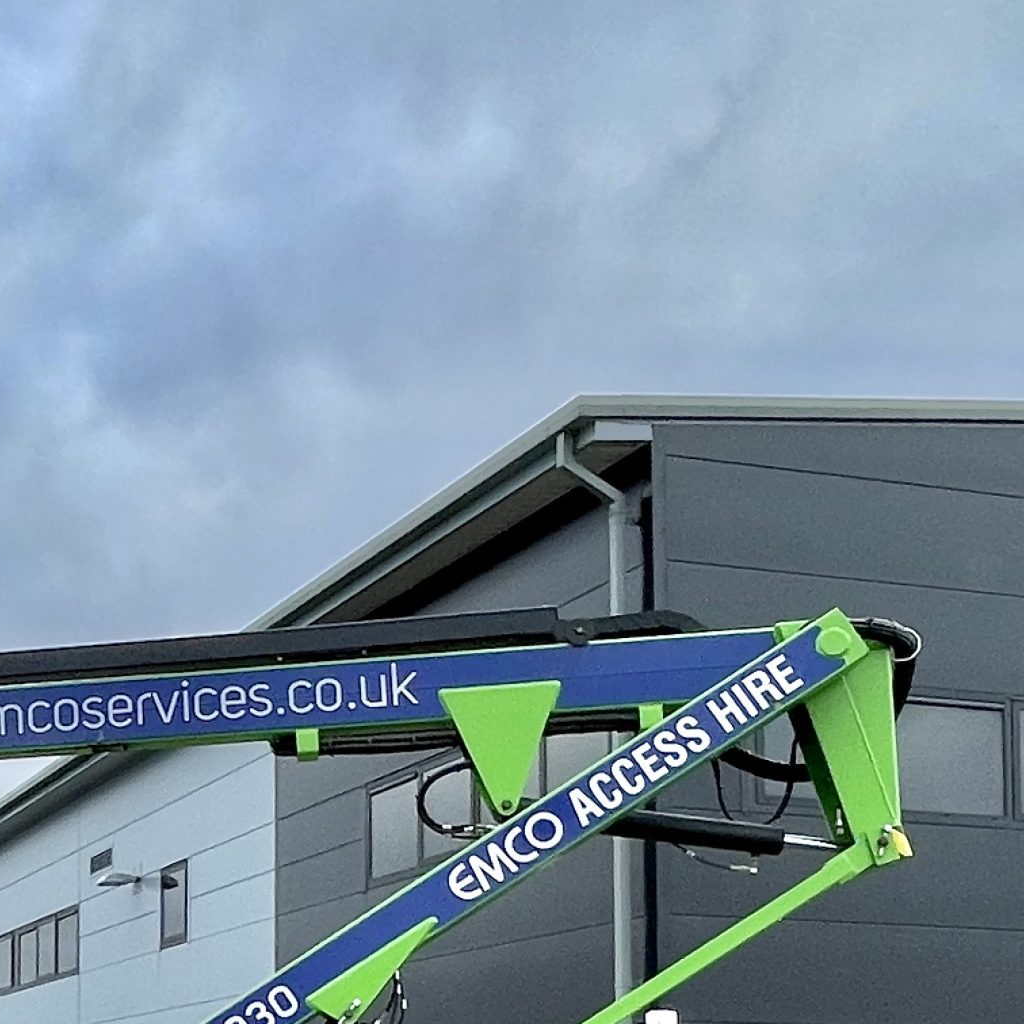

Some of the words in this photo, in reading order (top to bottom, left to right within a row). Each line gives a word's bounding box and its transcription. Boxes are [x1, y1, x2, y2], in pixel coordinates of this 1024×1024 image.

[448, 811, 564, 900] EMCO
[568, 715, 711, 828] ACCESS
[706, 653, 805, 734] HIRE
